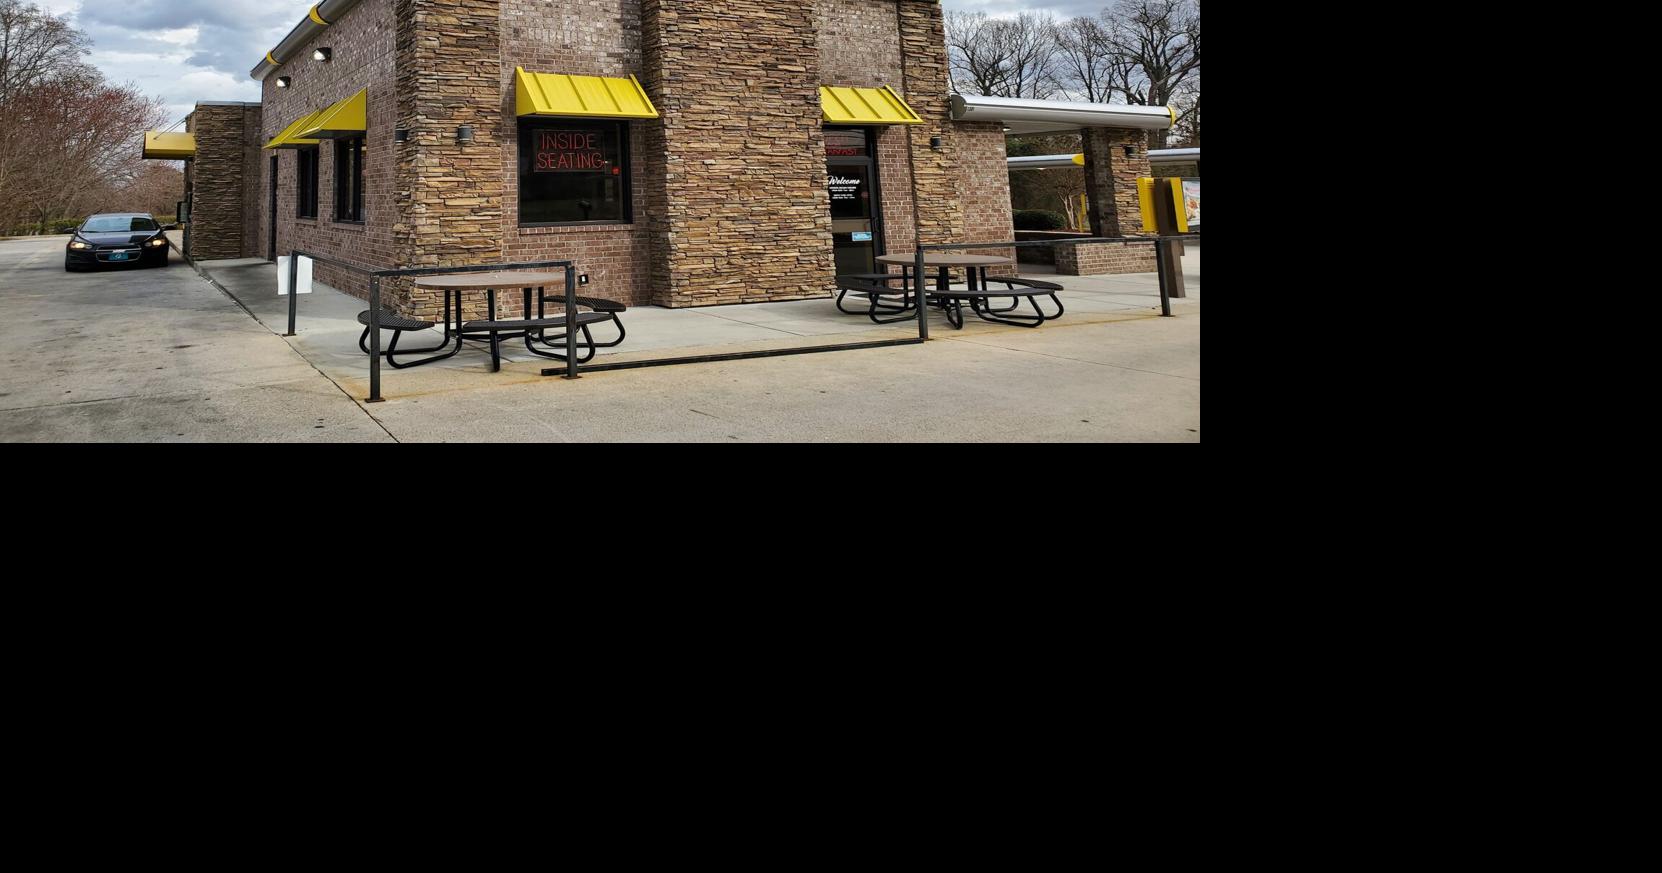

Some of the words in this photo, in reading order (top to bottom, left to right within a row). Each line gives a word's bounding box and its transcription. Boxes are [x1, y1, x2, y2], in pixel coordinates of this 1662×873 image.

[541, 133, 597, 150] INSIDE
[537, 152, 603, 169] SEATING
[828, 175, 860, 185] Welcome
